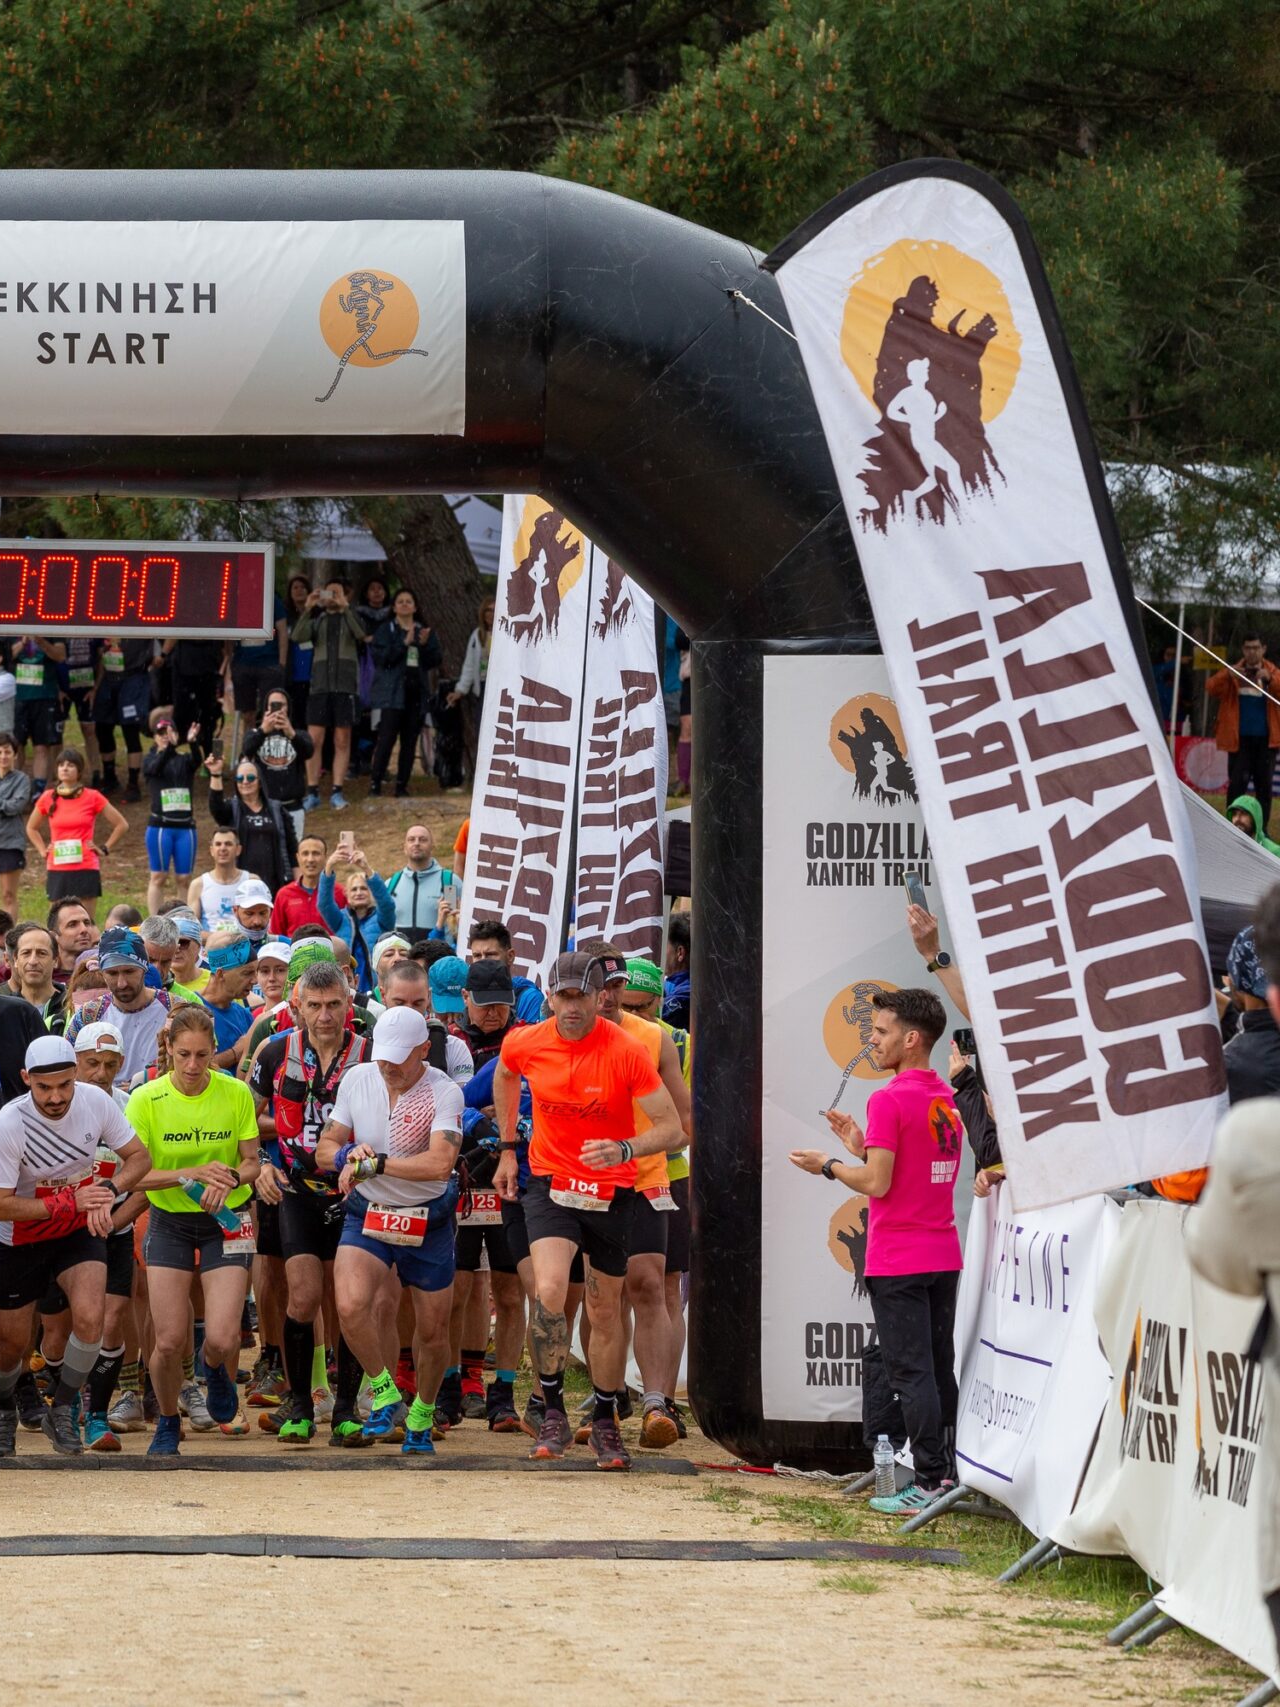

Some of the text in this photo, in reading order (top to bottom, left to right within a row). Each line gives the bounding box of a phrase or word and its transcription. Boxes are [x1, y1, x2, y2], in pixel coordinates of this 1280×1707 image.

[37, 332, 170, 364] START
[806, 862, 872, 887] XANTHI
[163, 1130, 232, 1143] IRON TEAM
[568, 1177, 599, 1195] 164
[380, 1213, 410, 1232] 120
